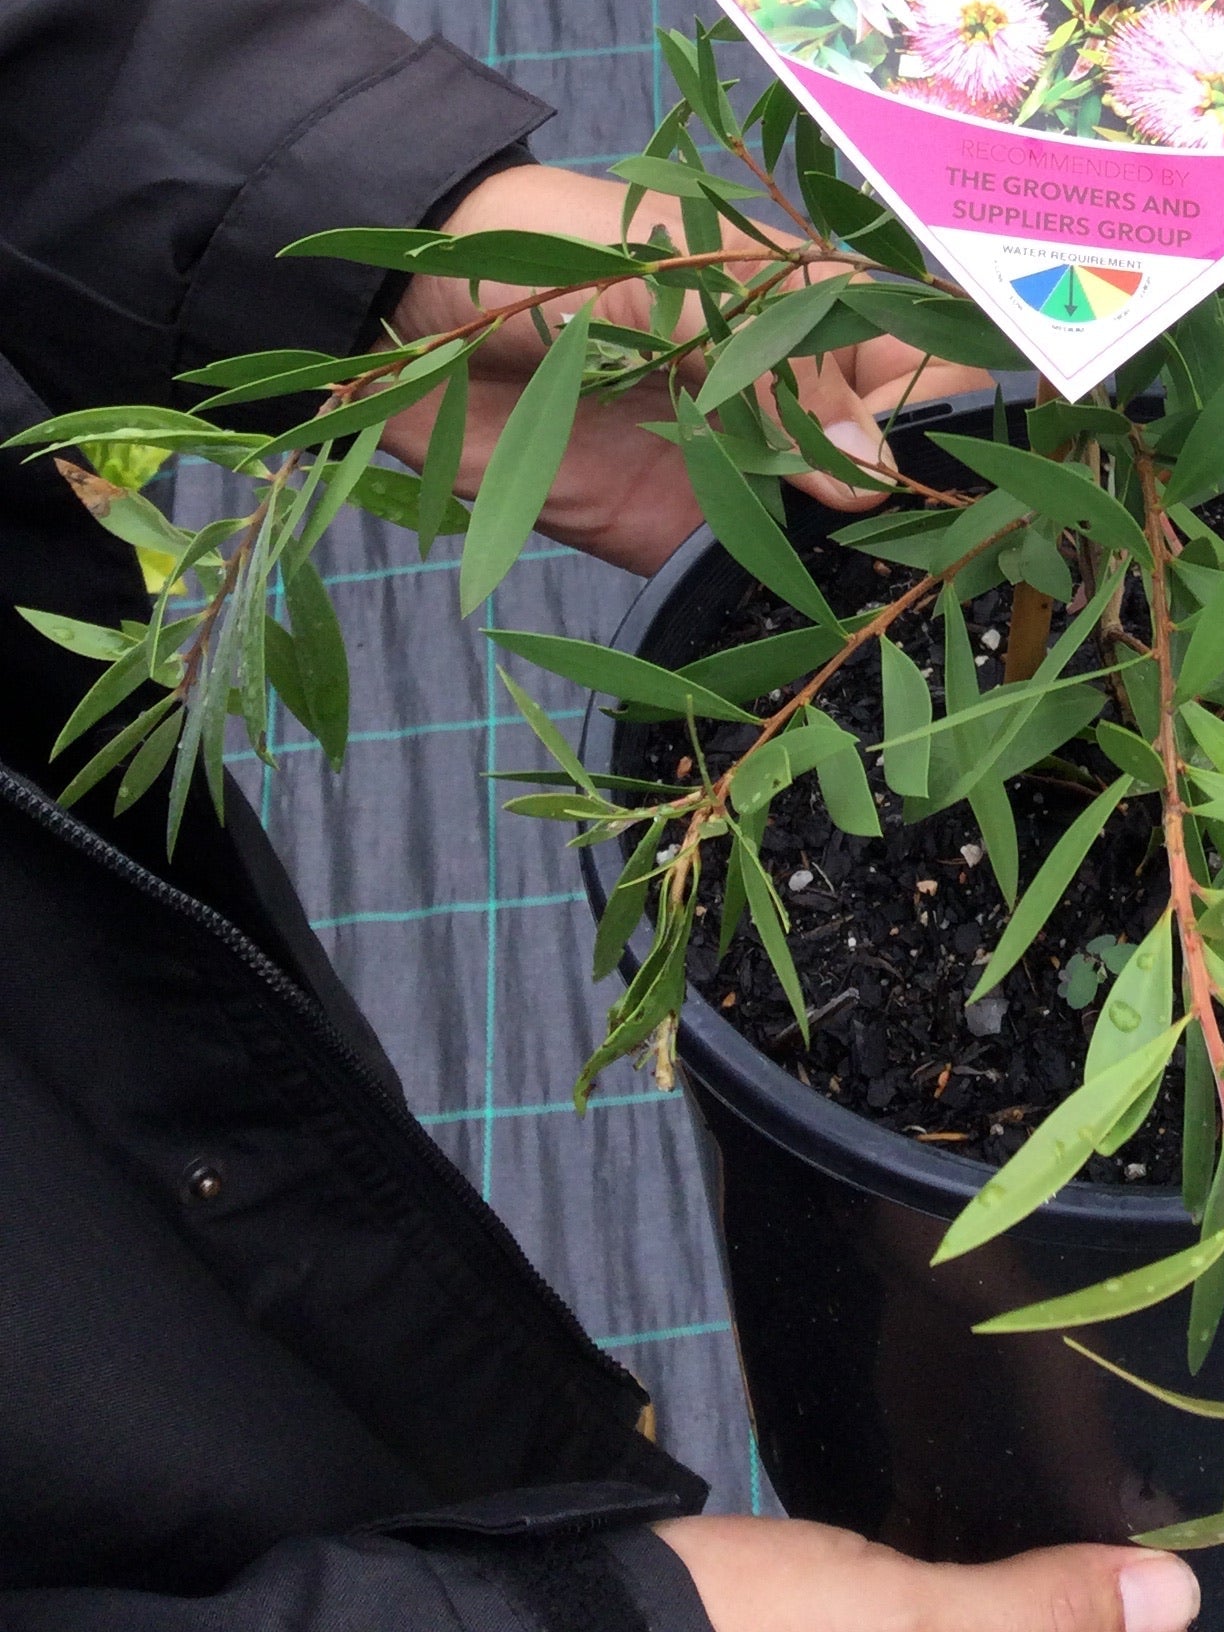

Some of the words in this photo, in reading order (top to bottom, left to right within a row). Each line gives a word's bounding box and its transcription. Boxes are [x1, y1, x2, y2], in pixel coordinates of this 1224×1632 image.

[961, 139, 1153, 183] RECOMMENDED
[1161, 169, 1190, 188] BY
[946, 166, 996, 192] THE
[1003, 175, 1136, 211] GROWERS
[1141, 195, 1201, 219] AND
[952, 199, 1090, 237] SUPPLIERS
[1097, 219, 1192, 248] GROUP
[1002, 244, 1047, 258] WATER
[1050, 250, 1142, 269] REQUIREMENT
